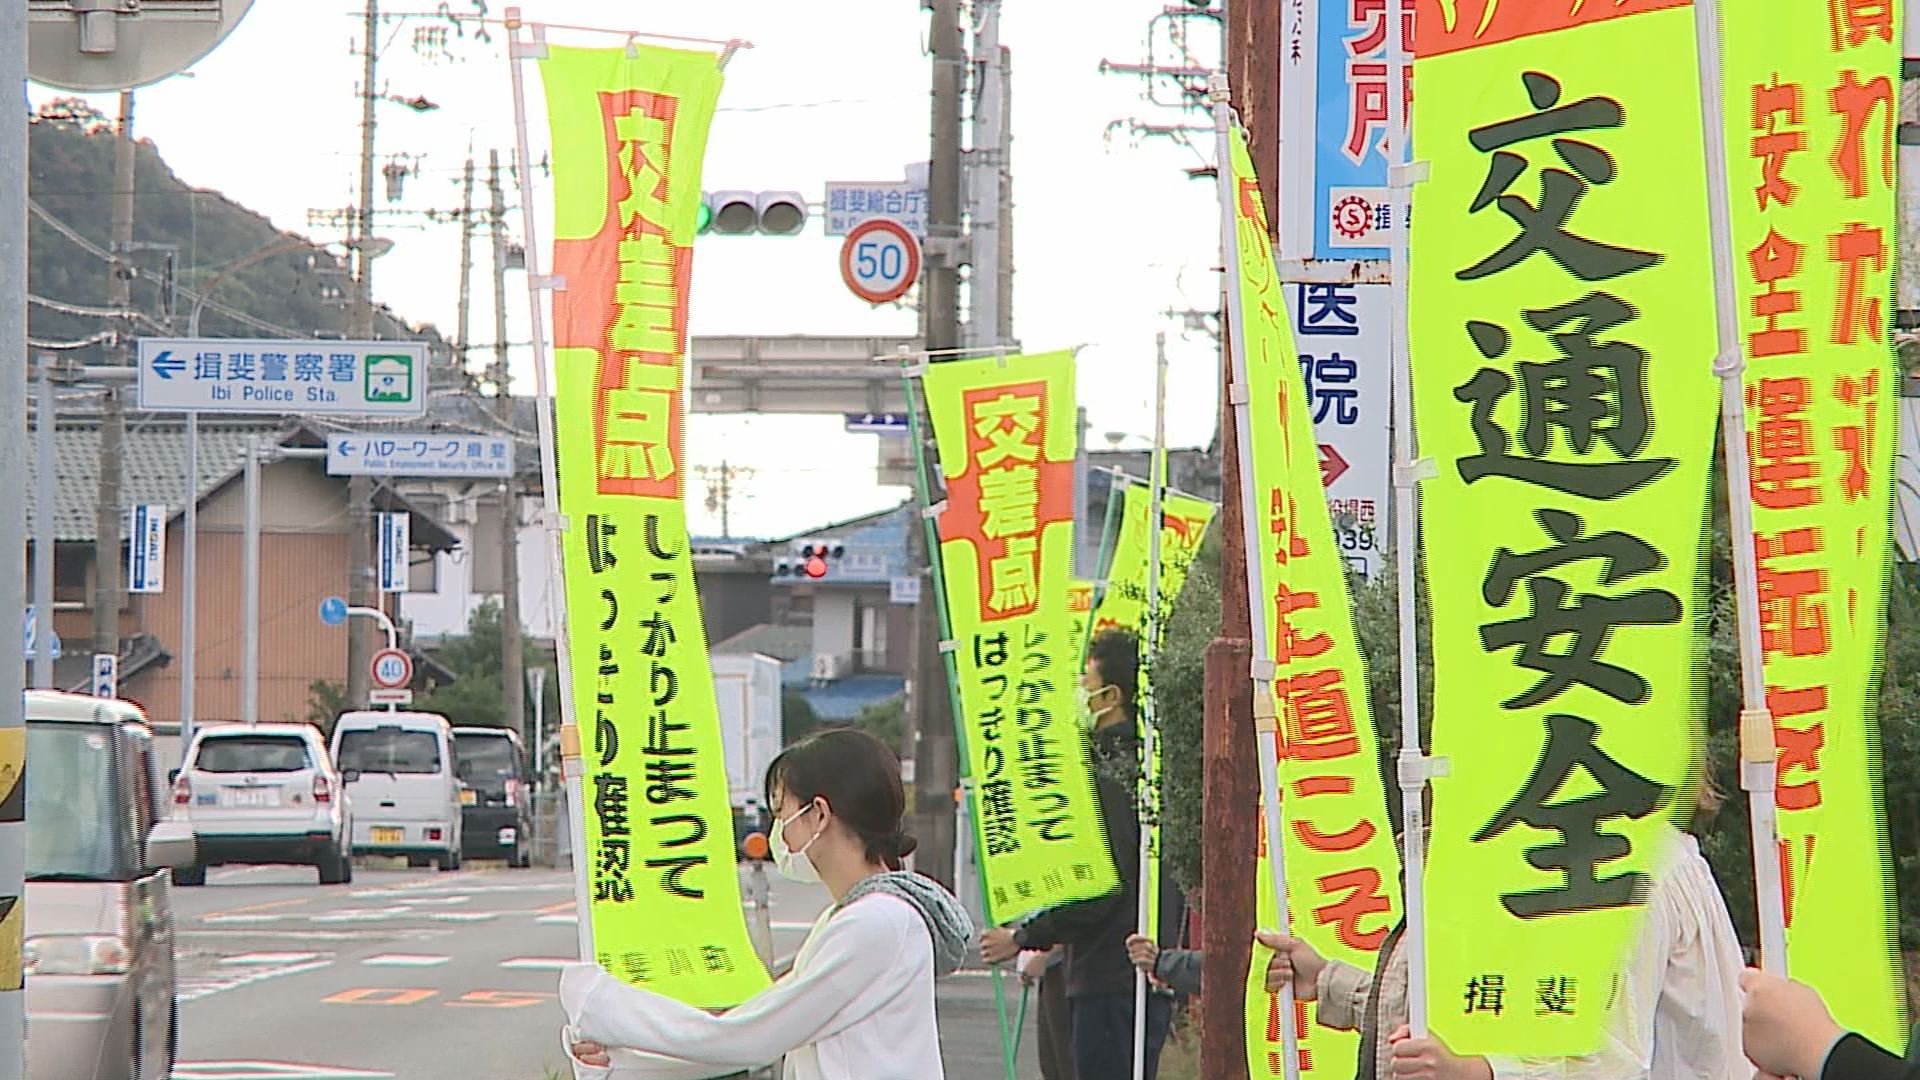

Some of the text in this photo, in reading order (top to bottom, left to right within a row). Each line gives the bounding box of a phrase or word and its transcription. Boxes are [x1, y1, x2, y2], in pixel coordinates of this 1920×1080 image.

[603, 106, 678, 482] 交差点
[857, 243, 902, 280] 50
[193, 352, 356, 382] 揖斐警察署
[211, 386, 231, 401] Ibi
[243, 386, 294, 401] Police
[1298, 283, 1360, 425] 医院
[972, 393, 1048, 613] 交差点
[1454, 70, 1686, 919] 交通安全
[381, 660, 403, 678] 40
[639, 513, 710, 901] しっかり止まって
[1014, 623, 1075, 845] しっかり止まって
